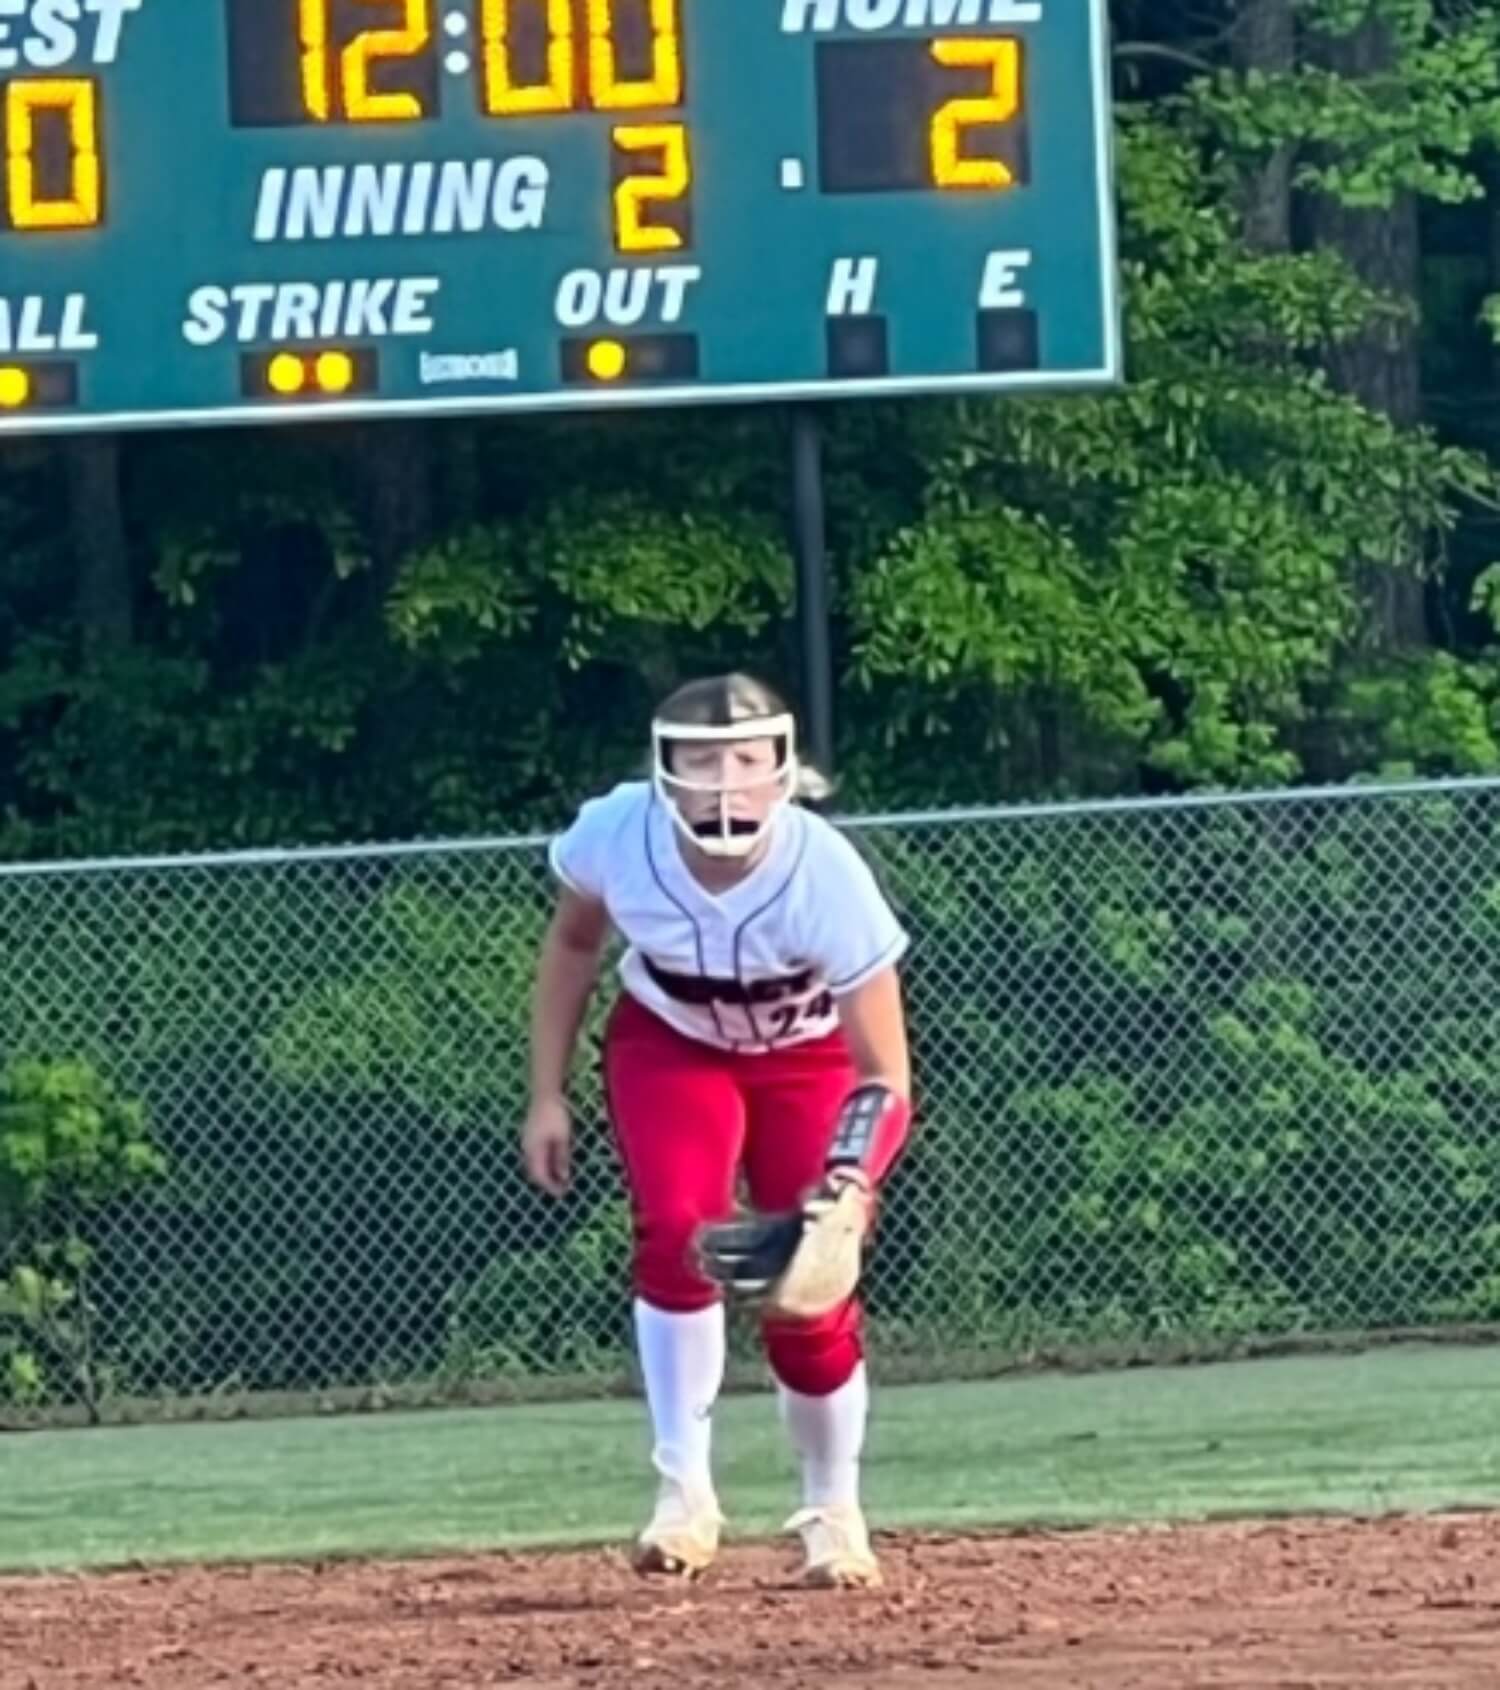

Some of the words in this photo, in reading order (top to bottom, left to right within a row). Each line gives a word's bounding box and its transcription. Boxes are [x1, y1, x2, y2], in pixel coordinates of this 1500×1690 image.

[299, 0, 681, 121] 12:00
[931, 37, 1019, 188] 2
[7, 78, 99, 230] 0
[612, 123, 690, 251] 2
[253, 157, 549, 241] INNING
[183, 277, 440, 344] STRIKE
[555, 265, 701, 326] OUT
[825, 257, 877, 315] H
[979, 250, 1031, 308] E
[0, 293, 98, 351] LL
[768, 990, 834, 1040] 24
